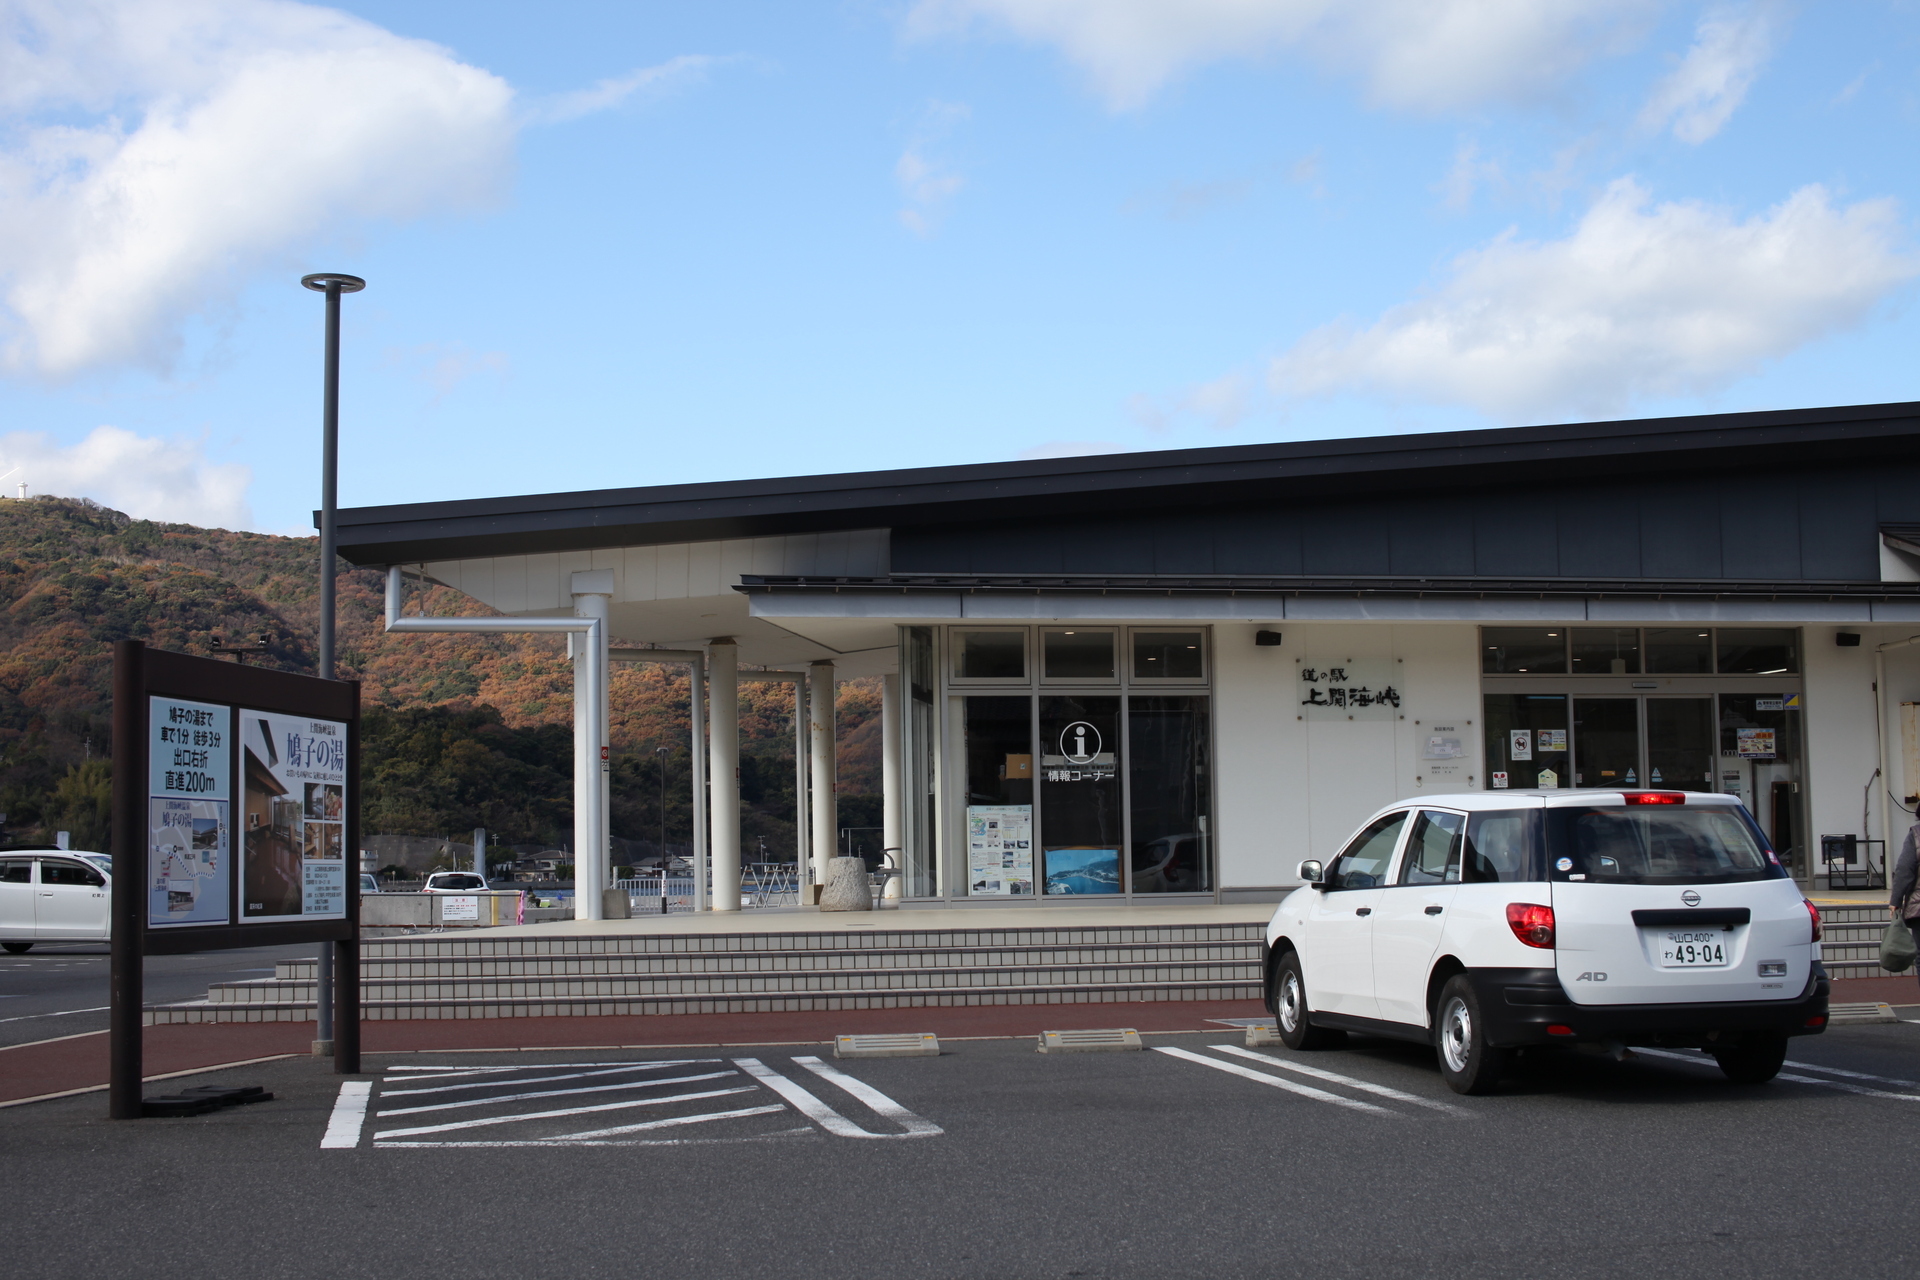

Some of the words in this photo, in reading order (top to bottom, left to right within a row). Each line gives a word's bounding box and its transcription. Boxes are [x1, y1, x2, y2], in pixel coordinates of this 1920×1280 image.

[1301, 667, 1349, 683] 道の駅
[1301, 686, 1401, 710] 上関海峡
[169, 705, 214, 727] 鳩子の湯まで
[161, 726, 189, 745] 車で1分
[193, 729, 221, 748] 徒歩3分
[174, 747, 208, 769] 出口右折
[286, 732, 344, 772] 鳩子の湯
[165, 770, 216, 793] 直進200m
[1047, 770, 1115, 783] 情報コーナー
[162, 811, 192, 828] 鳩子の湯
[1675, 944, 1723, 963] 49-04
[1576, 971, 1608, 982] AD
